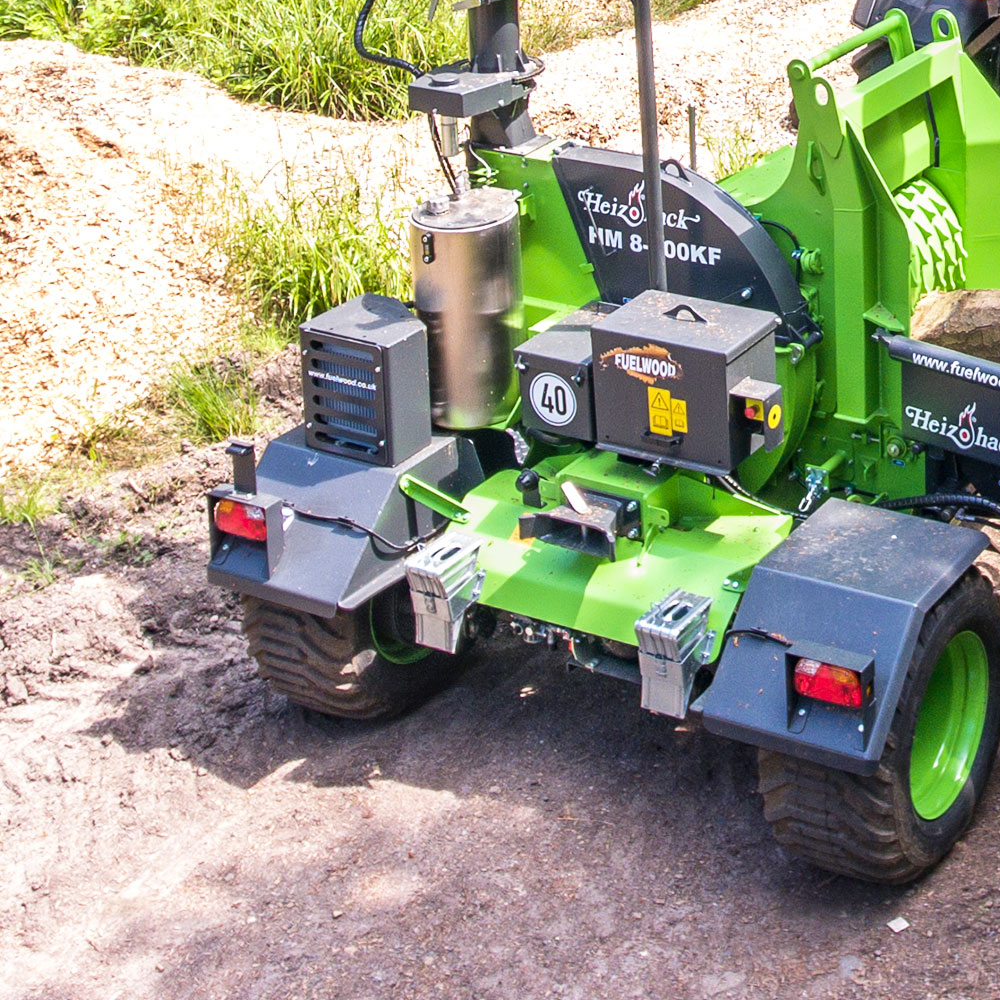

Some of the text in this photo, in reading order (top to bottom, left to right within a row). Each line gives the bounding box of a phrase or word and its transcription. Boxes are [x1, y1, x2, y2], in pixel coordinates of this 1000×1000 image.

[578, 180, 701, 230] Heizock
[588, 225, 721, 266] HM 8-00KF
[615, 353, 676, 377] FUELWOOD
[541, 383, 567, 415] 40
